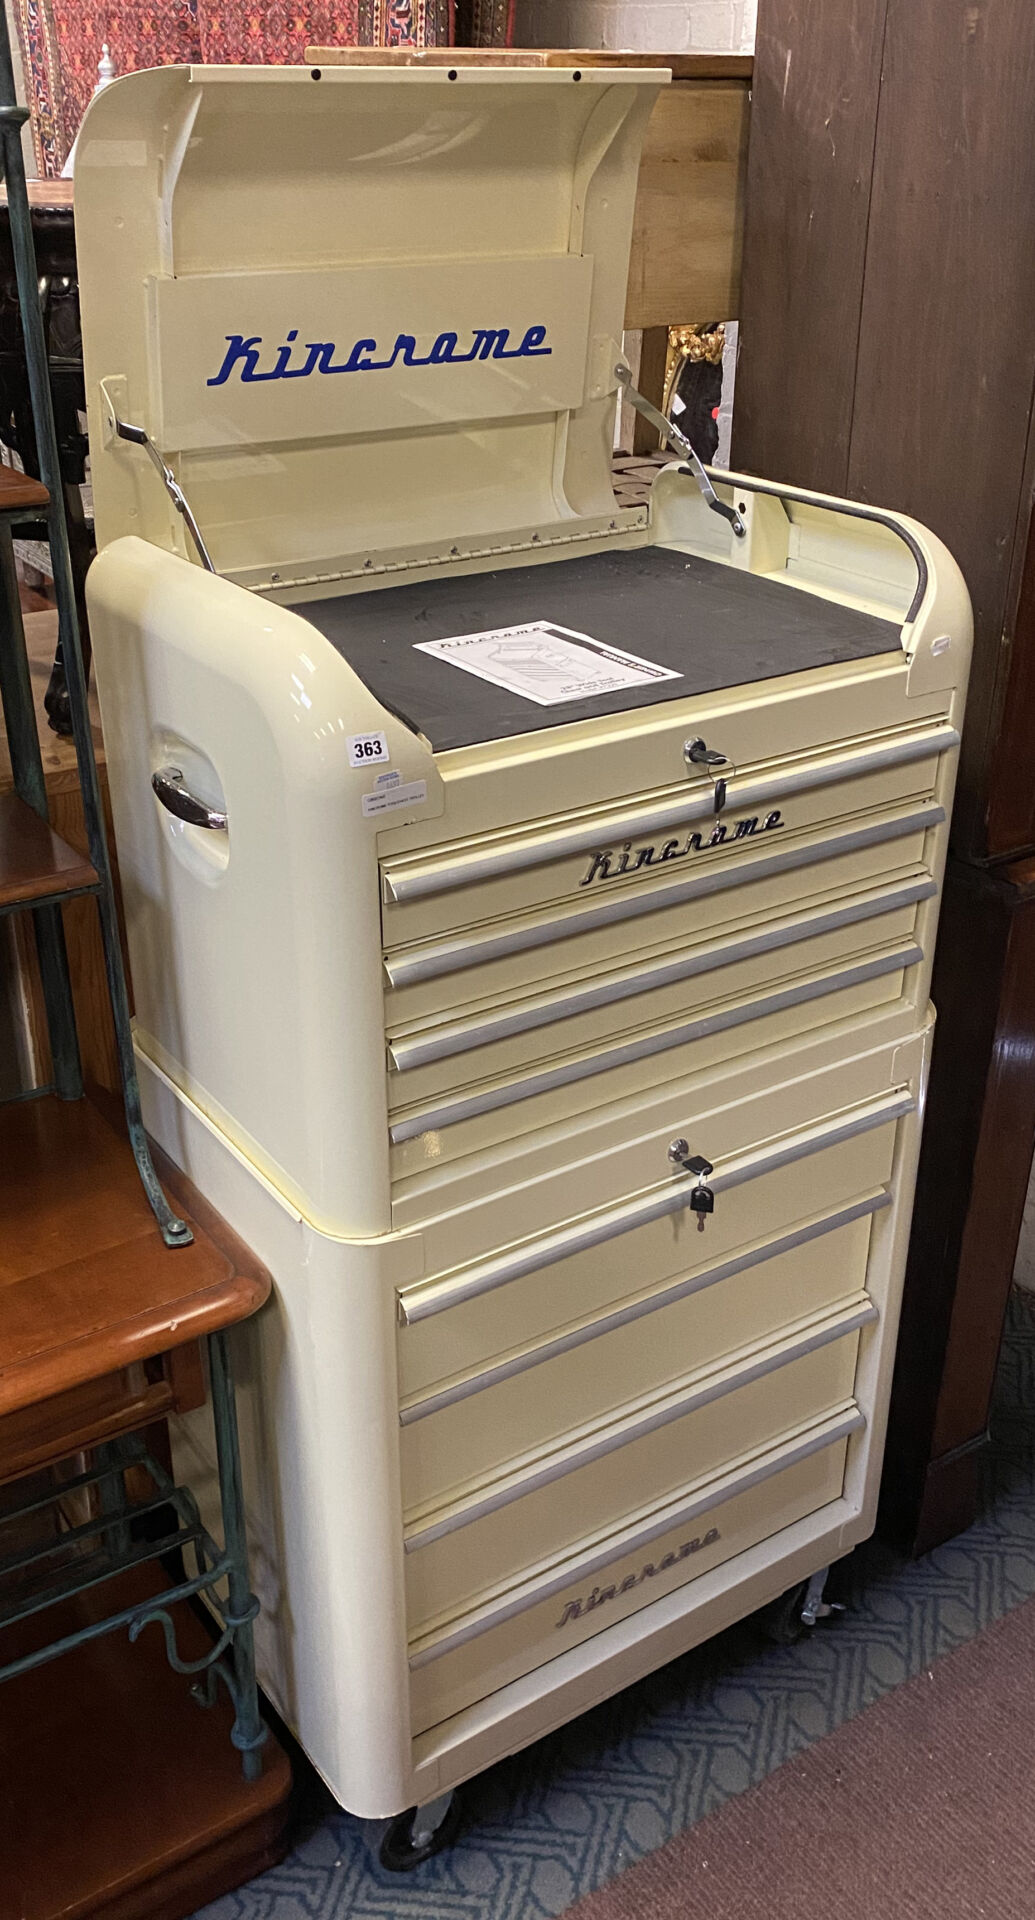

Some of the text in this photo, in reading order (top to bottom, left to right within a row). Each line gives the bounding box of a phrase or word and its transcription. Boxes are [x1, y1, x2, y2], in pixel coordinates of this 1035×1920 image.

[206, 325, 552, 387] Kincrome
[354, 740, 382, 759] 363
[579, 809, 785, 887] Kincrome
[554, 1526, 722, 1629] Kincrome
